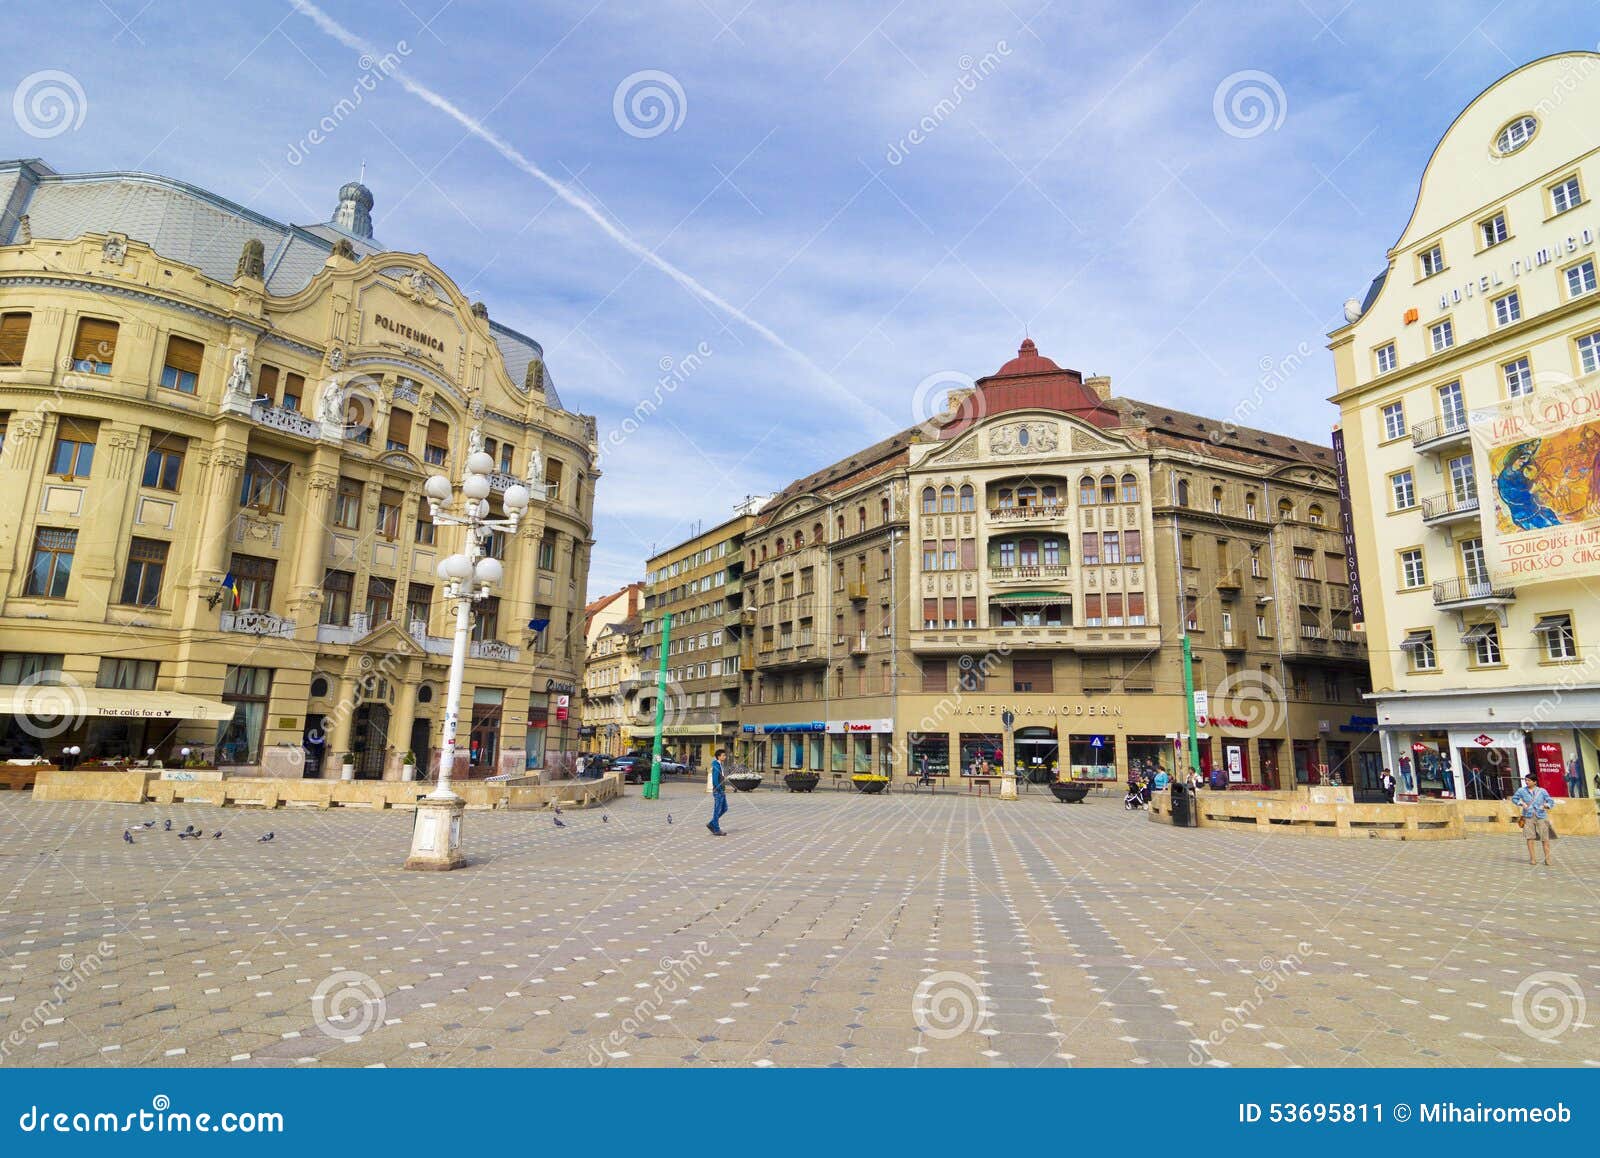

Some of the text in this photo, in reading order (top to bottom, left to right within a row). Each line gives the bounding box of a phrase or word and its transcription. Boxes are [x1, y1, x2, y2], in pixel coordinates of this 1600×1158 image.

[1439, 226, 1600, 310] HOTEL TIMISO
[374, 313, 445, 353] POLITEHNICA
[1335, 439, 1348, 500] HOTEL
[1511, 554, 1564, 574] PICASSO
[97, 707, 118, 715] That
[120, 708, 140, 716] calls
[142, 709, 155, 717] for
